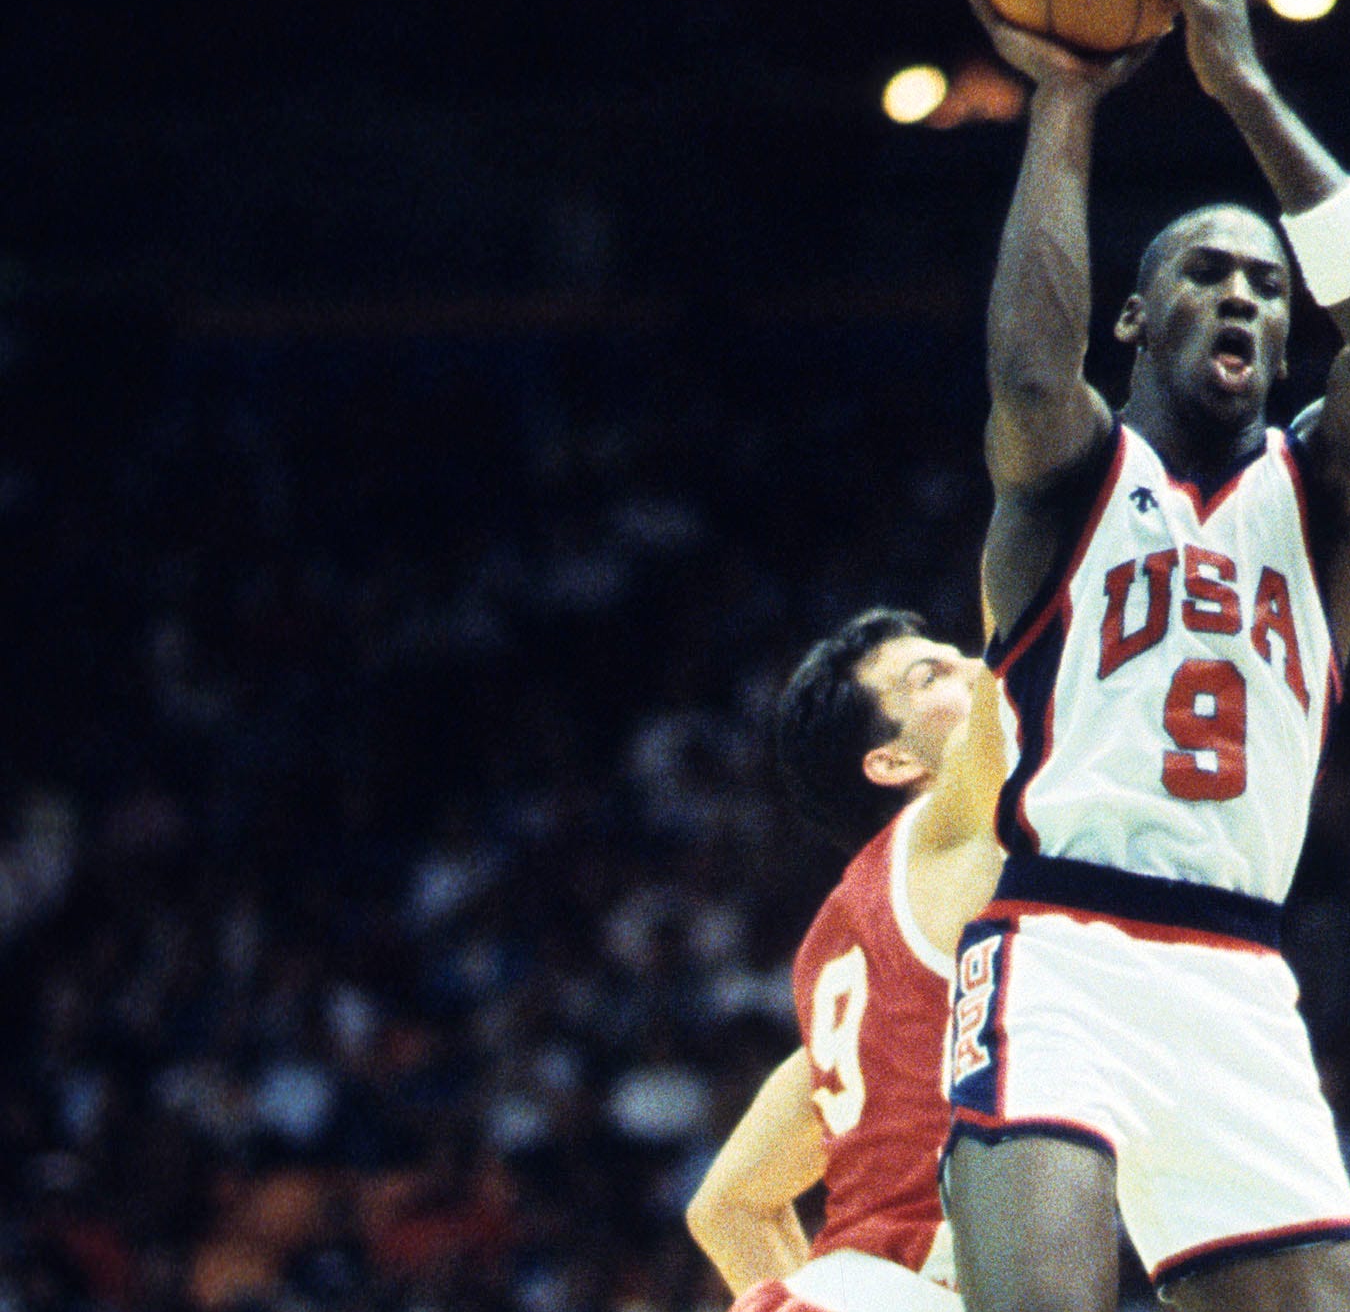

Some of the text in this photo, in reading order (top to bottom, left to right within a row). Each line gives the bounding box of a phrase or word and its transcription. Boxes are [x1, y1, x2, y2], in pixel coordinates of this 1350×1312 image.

[1098, 544, 1312, 716] USA
[1161, 656, 1249, 803] 9
[809, 943, 868, 1139] 9
